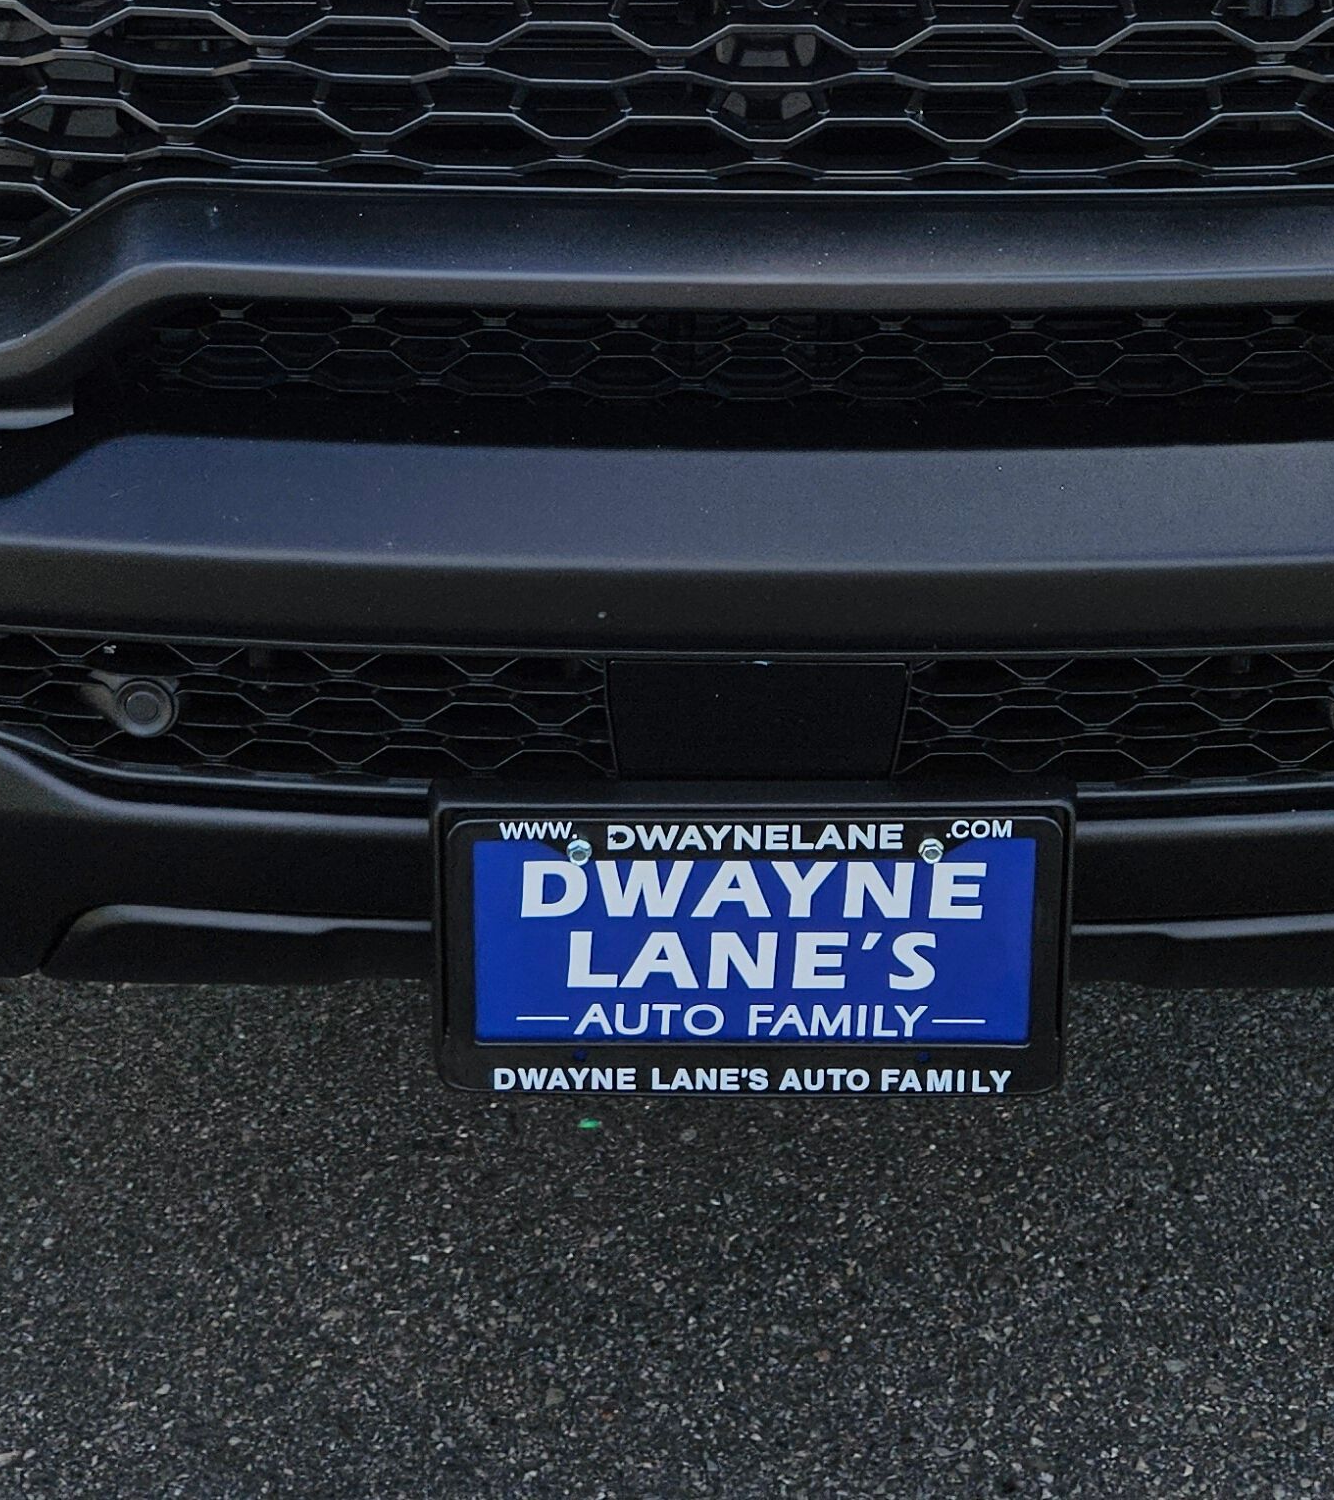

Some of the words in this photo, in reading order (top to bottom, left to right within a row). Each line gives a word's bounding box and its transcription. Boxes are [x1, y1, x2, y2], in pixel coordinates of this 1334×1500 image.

[607, 824, 905, 851] DWAYNELANE
[519, 860, 988, 920] DWAYNE
[567, 930, 937, 991] LANE'S
[574, 1003, 725, 1037] AUTO
[748, 1004, 928, 1038] FAMILY
[493, 1067, 637, 1091] DWAYNE
[651, 1068, 769, 1092] LANE'S
[779, 1068, 871, 1093] AUTO
[881, 1069, 1012, 1094] FAMILY
